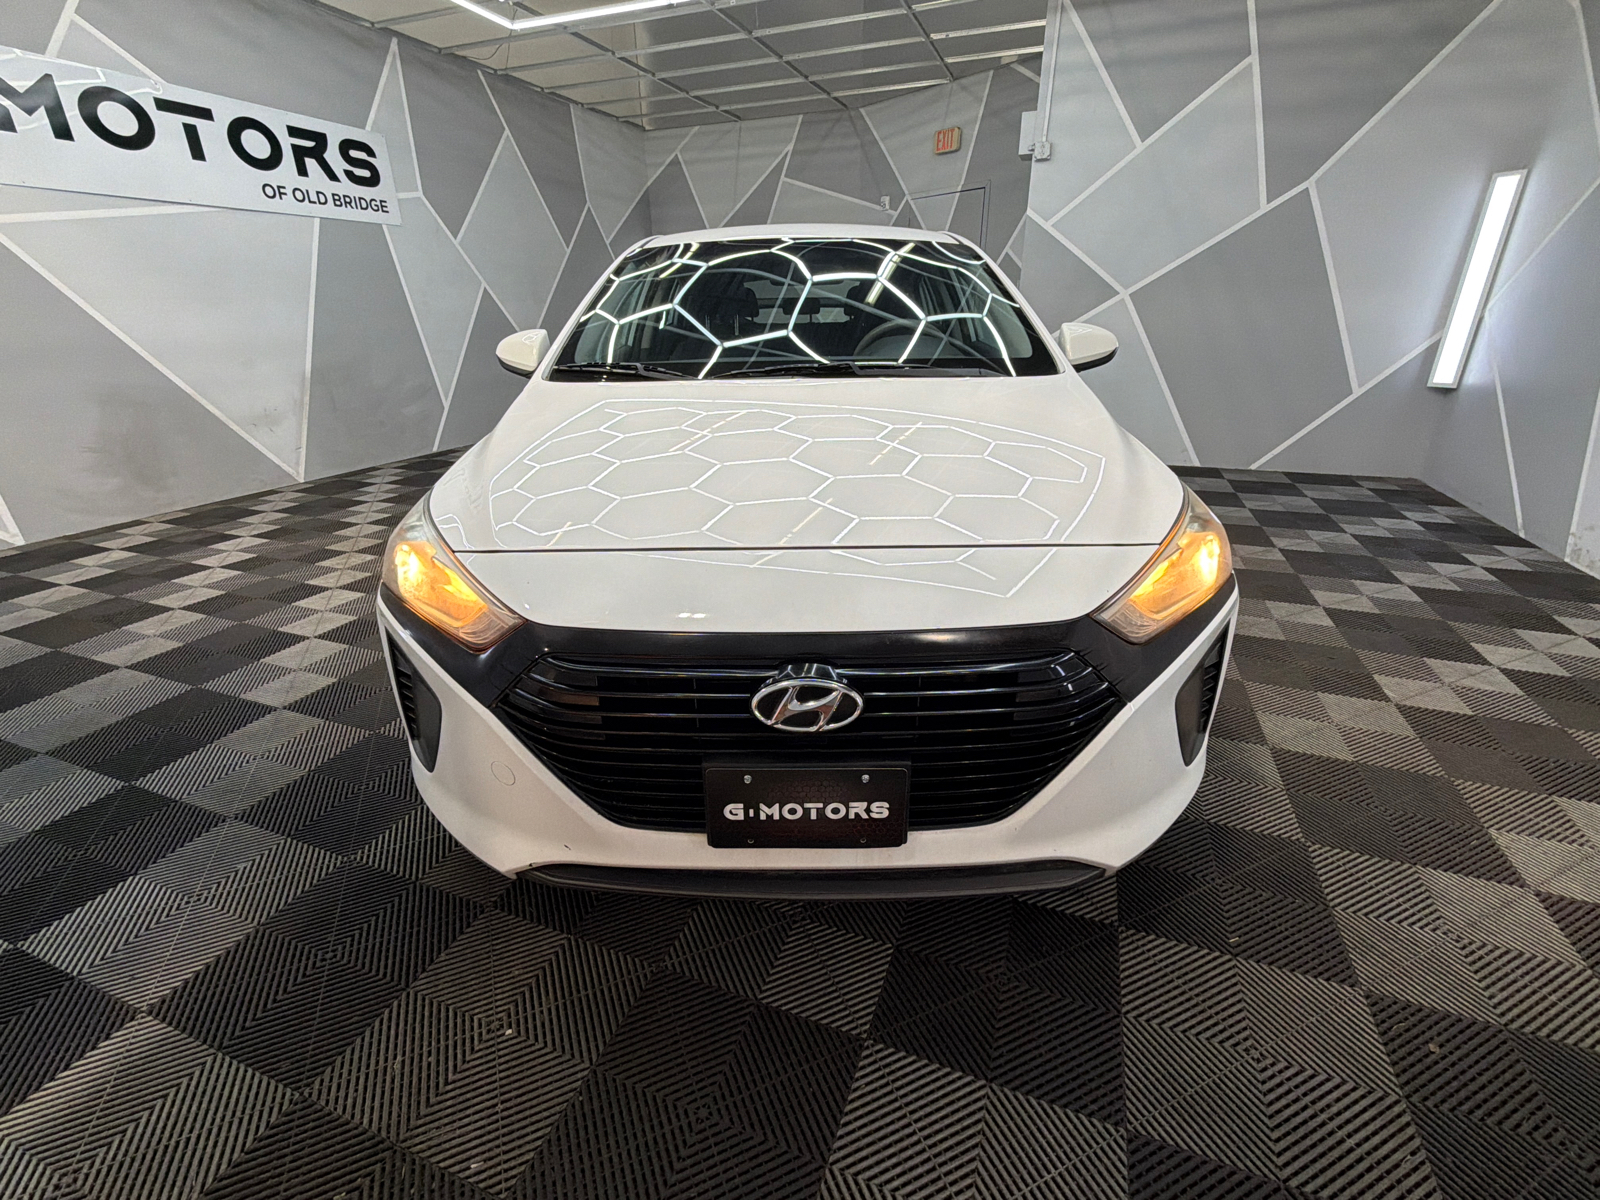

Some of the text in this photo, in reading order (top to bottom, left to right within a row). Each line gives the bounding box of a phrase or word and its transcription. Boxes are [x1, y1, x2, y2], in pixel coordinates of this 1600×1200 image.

[936, 128, 956, 151] EXIT
[261, 182, 390, 214] OF OLD BRIDGE
